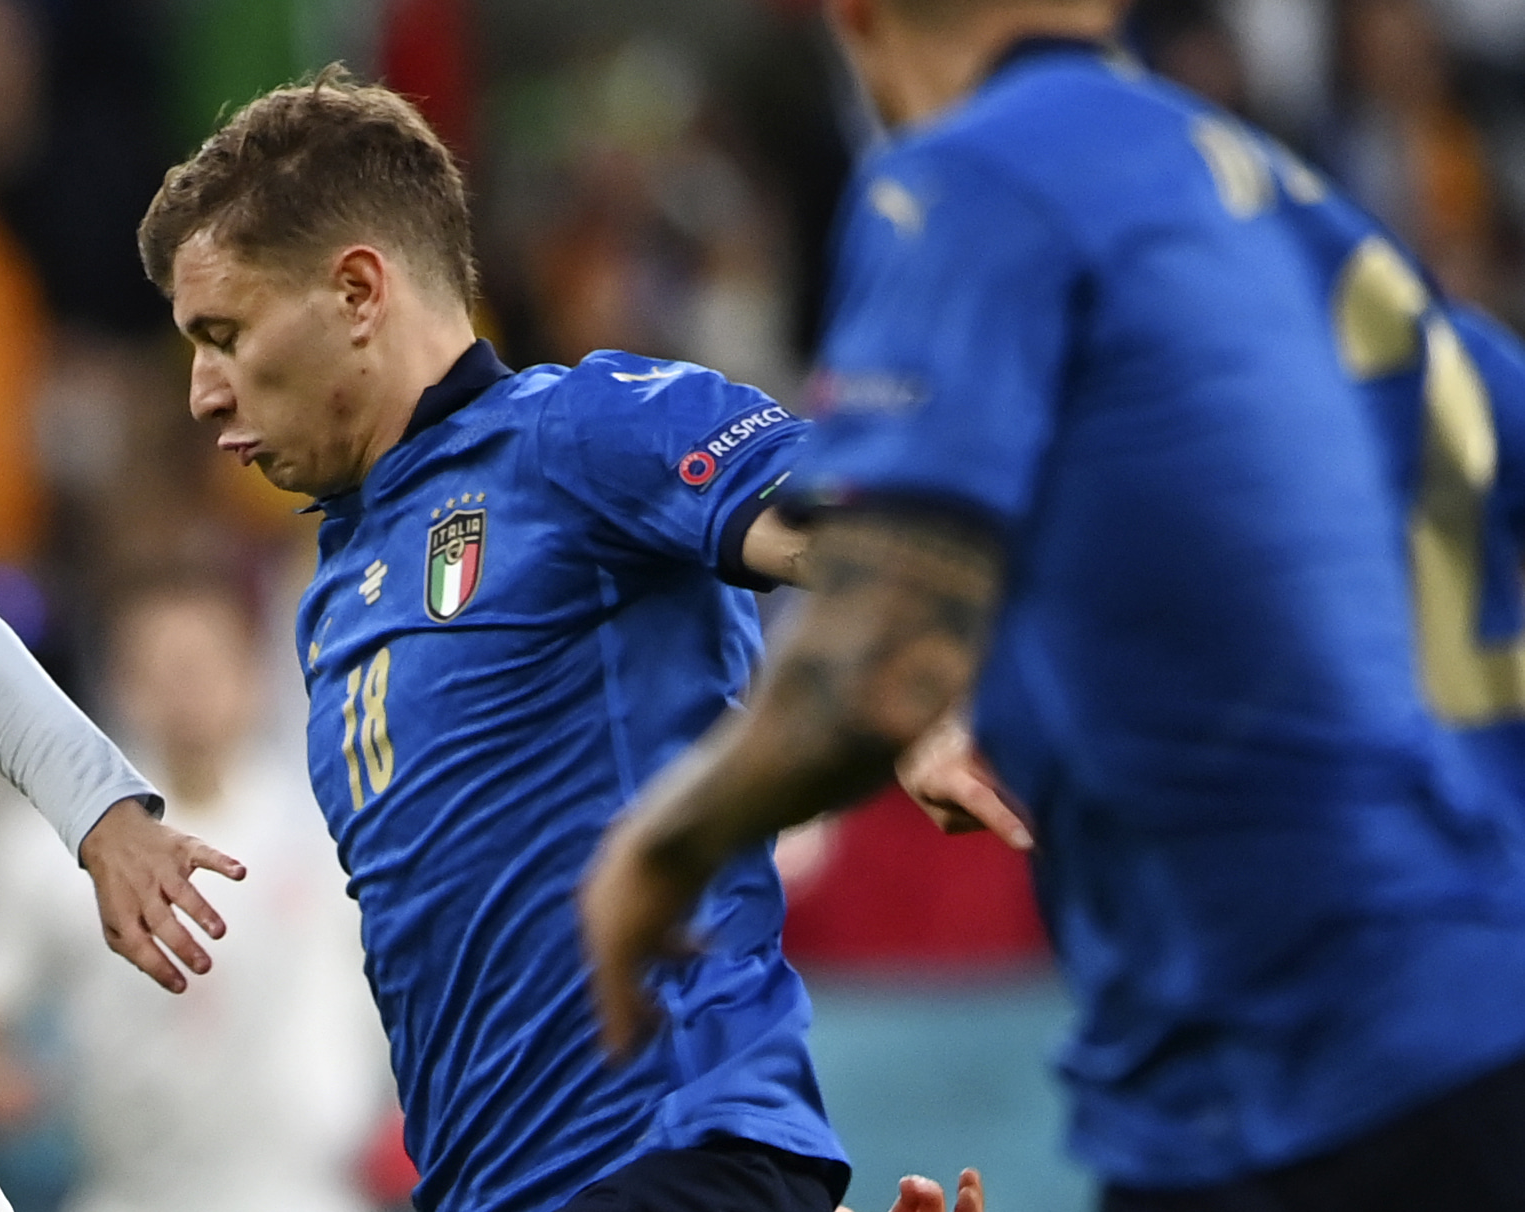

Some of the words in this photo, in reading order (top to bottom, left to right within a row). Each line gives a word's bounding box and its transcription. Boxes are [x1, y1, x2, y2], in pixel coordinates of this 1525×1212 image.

[707, 405, 790, 457] RESPECT
[433, 517, 481, 548] ITALIA
[342, 647, 395, 812] 18
